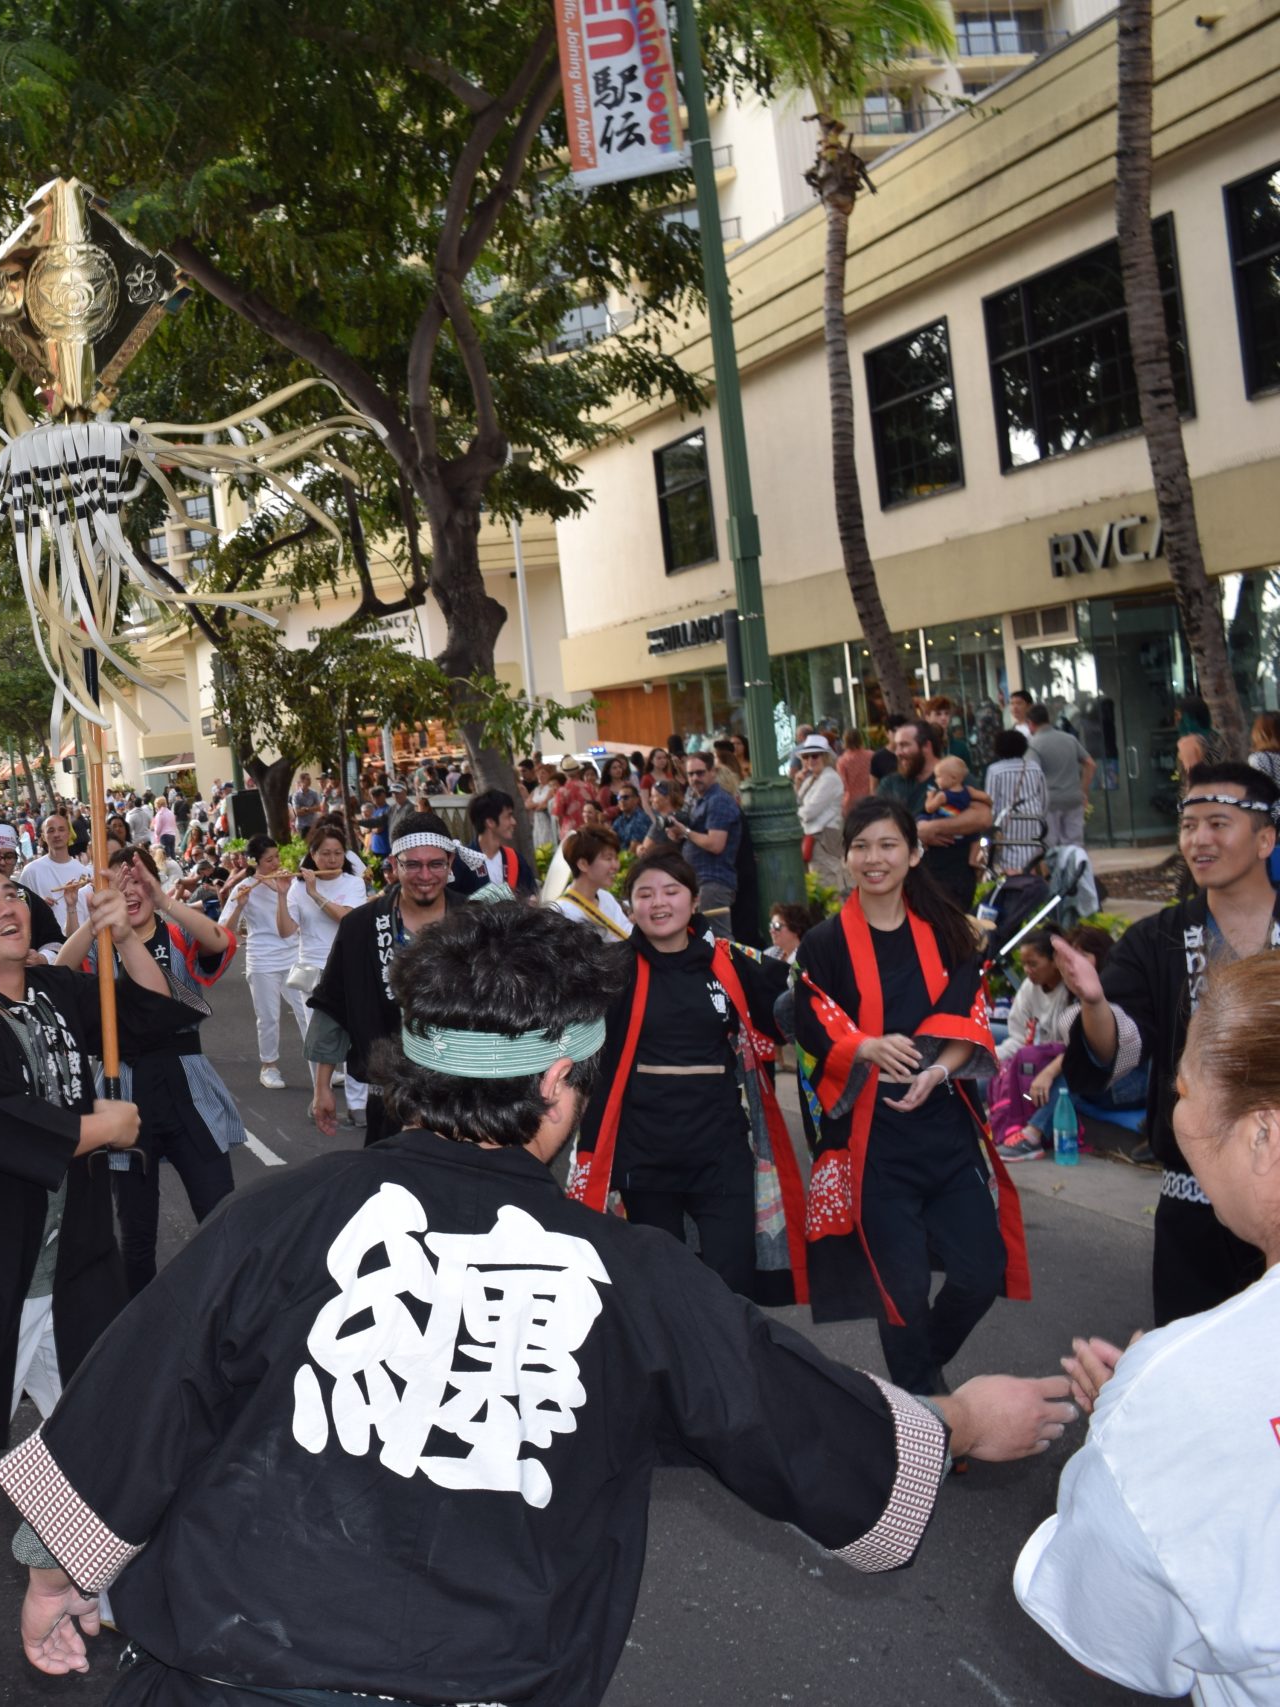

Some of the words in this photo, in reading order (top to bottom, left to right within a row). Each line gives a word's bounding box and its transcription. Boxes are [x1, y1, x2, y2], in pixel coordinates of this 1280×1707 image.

[566, 28, 583, 80] Joining
[572, 83, 587, 113] with
[593, 64, 646, 154] 駅伝
